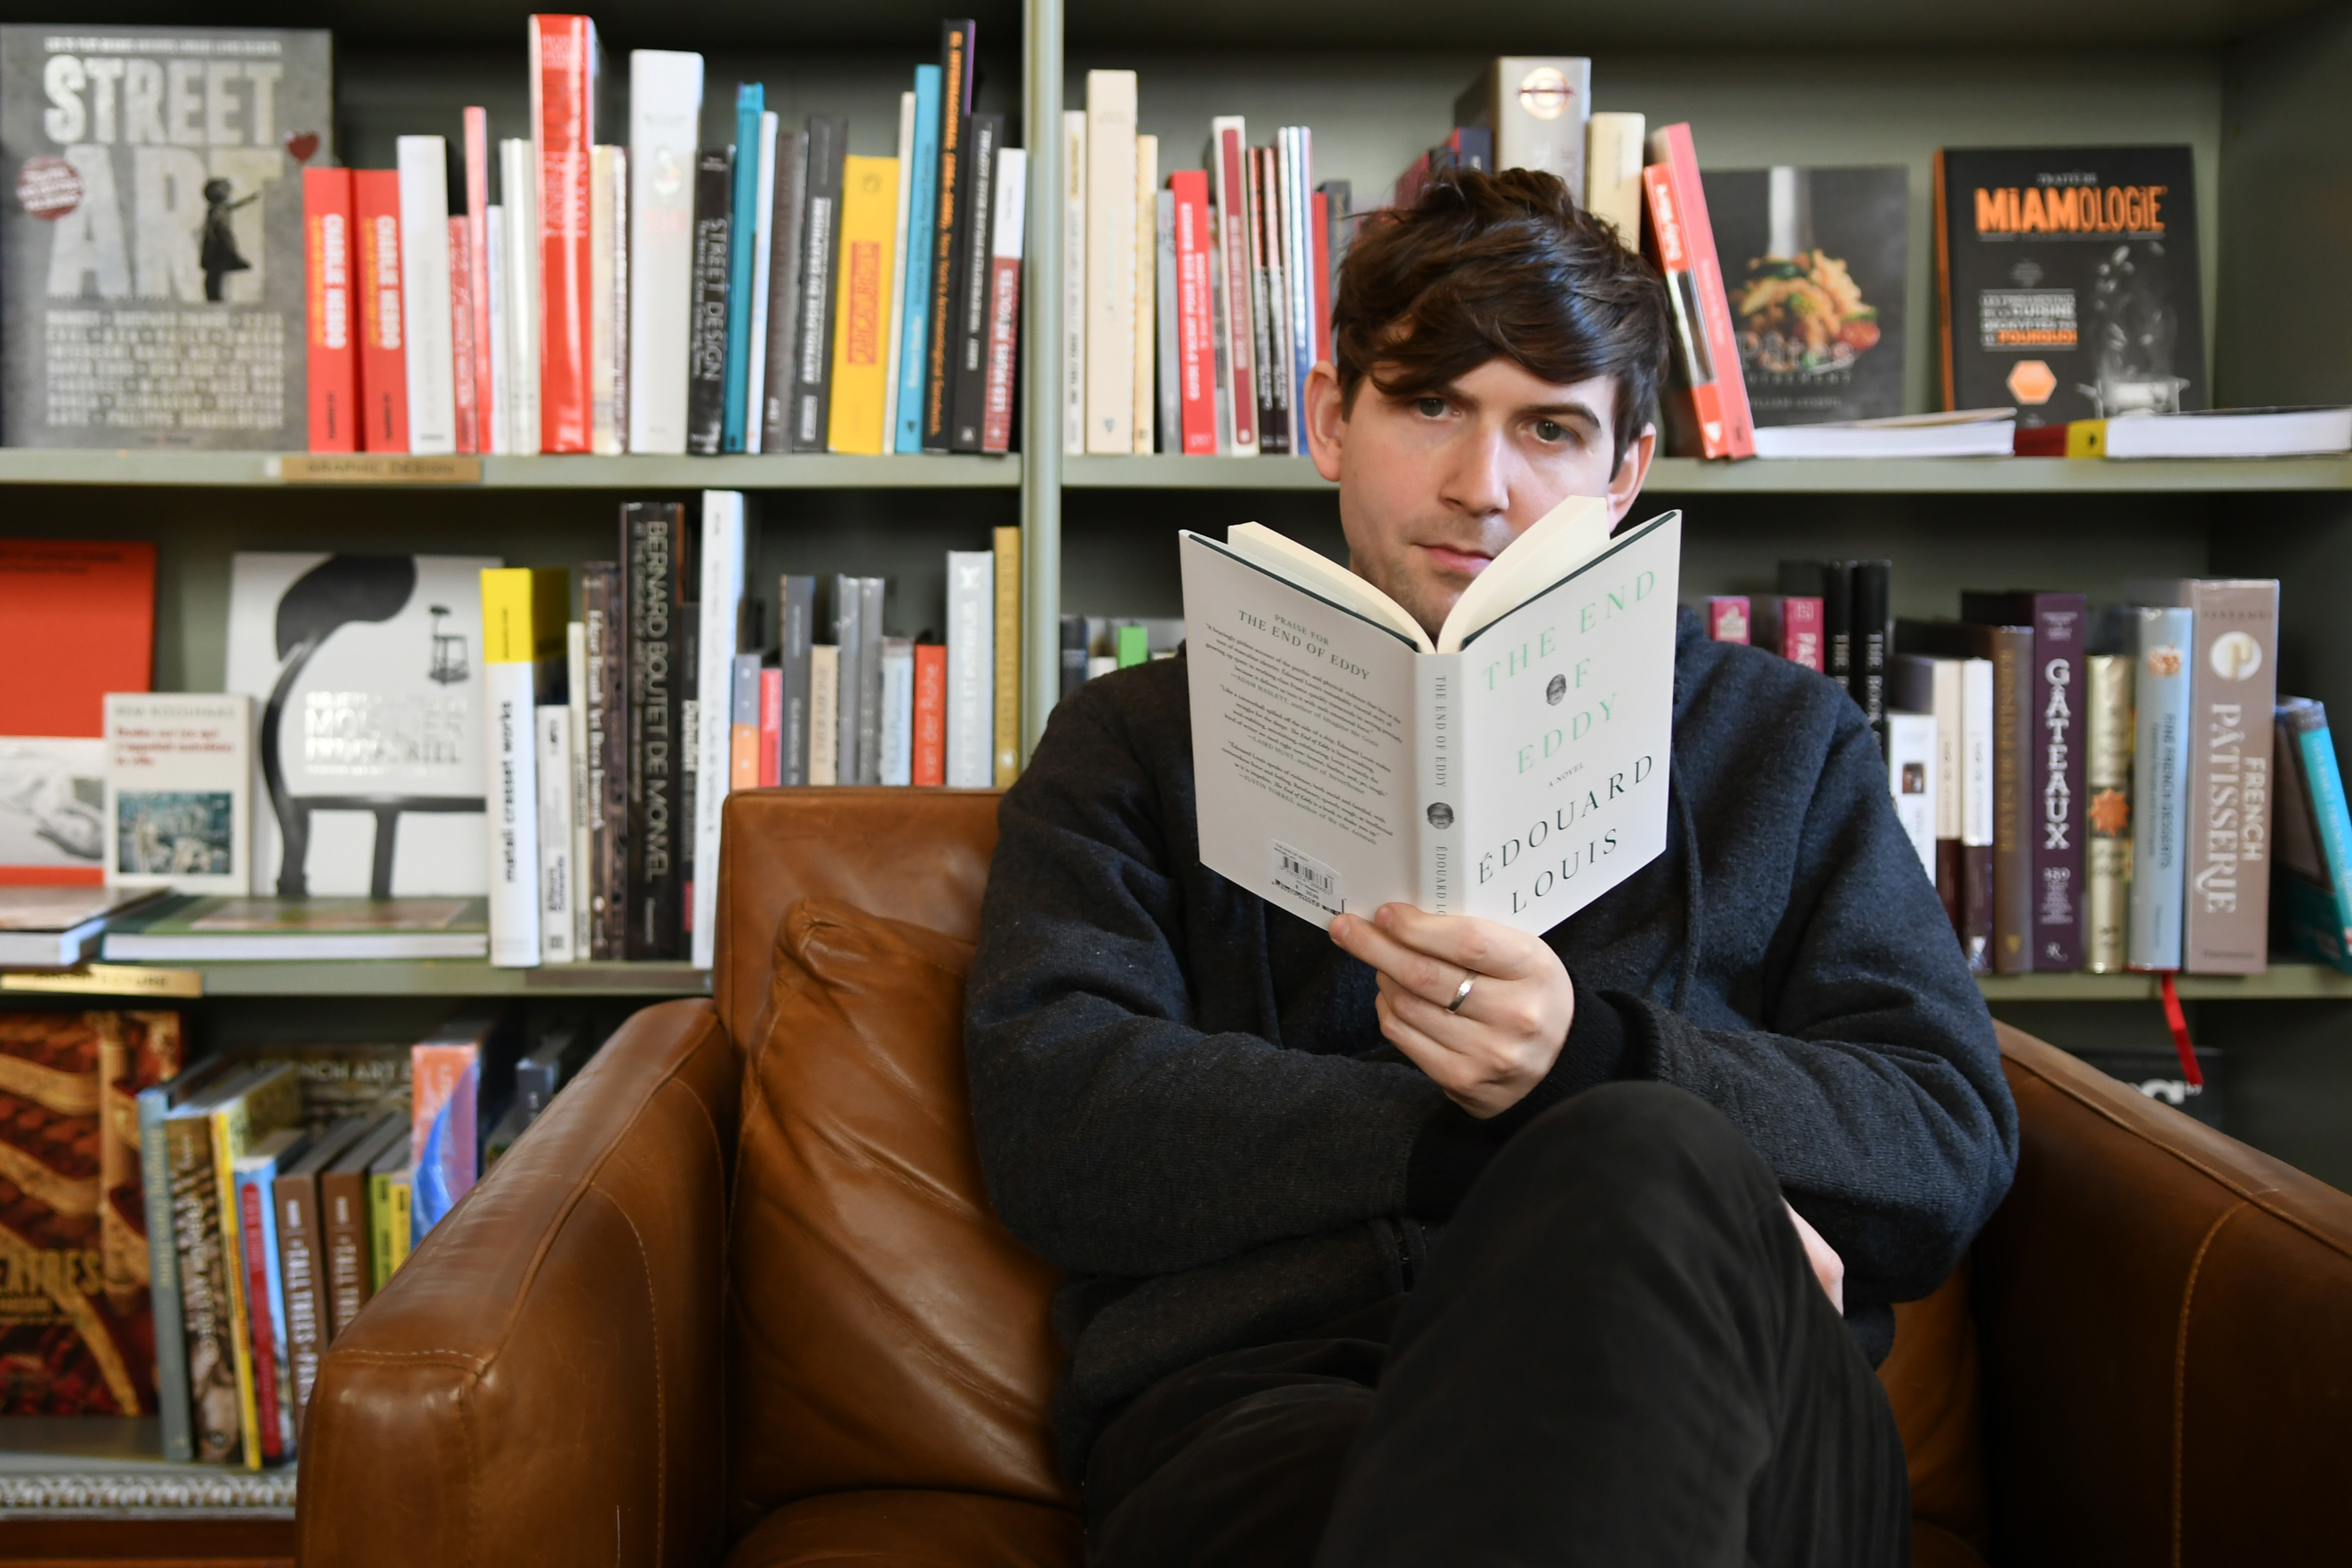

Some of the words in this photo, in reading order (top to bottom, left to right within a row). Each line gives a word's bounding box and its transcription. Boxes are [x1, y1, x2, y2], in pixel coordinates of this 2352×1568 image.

[45, 54, 283, 145] STREET
[47, 145, 284, 304] ART
[706, 218, 728, 295] STREET
[702, 301, 724, 381] DESIGN
[646, 521, 668, 638] BERNARD
[1239, 610, 1266, 631] THE
[1272, 626, 1301, 646] END
[1306, 643, 1325, 656] OF
[1330, 654, 1369, 679] EDDY
[1275, 614, 1307, 634] PRAISE
[1310, 631, 1328, 645] FOR
[1483, 625, 1557, 692] THE
[1579, 569, 1657, 631] END
[1865, 630, 1884, 670] THE
[646, 640, 668, 734] BOUTET
[920, 664, 939, 710] Rohe
[1230, 673, 1255, 687] —ADAM
[1290, 702, 1312, 714] author
[1323, 716, 1349, 731] Imagine
[1361, 735, 1378, 747] Gone
[1435, 675, 1447, 700] THE
[1435, 705, 1447, 731] END
[1865, 674, 1884, 726] BOOK
[500, 701, 514, 753] works
[646, 741, 667, 775] DE
[922, 714, 938, 744] der
[1435, 735, 1447, 751] OF
[1517, 693, 1619, 776] EDDY
[501, 760, 516, 824] crasset
[924, 746, 937, 777] van
[1247, 735, 1273, 749] —LAIRD
[1297, 758, 1318, 771] author
[1328, 773, 1364, 794] Neverhome
[1436, 756, 1447, 788] EDDY
[1548, 780, 1554, 789] A
[1556, 762, 1585, 782] NOVEL
[2162, 746, 2176, 797] FRENCH
[644, 780, 666, 882] MONVEL
[1238, 773, 1266, 789] —JUSTIN
[1296, 802, 1317, 814] author
[1338, 822, 1349, 831] the
[1351, 829, 1376, 844] Animals
[1478, 755, 1654, 886] ÉDOUARD
[2160, 803, 2174, 869] DESSERTS
[2193, 703, 2245, 915] PÂTISSERIE
[2242, 757, 2266, 862] FRENCH
[501, 828, 516, 883] matali
[1436, 846, 1448, 900] ÉDOUARD
[1511, 828, 1618, 915] LOUIS
